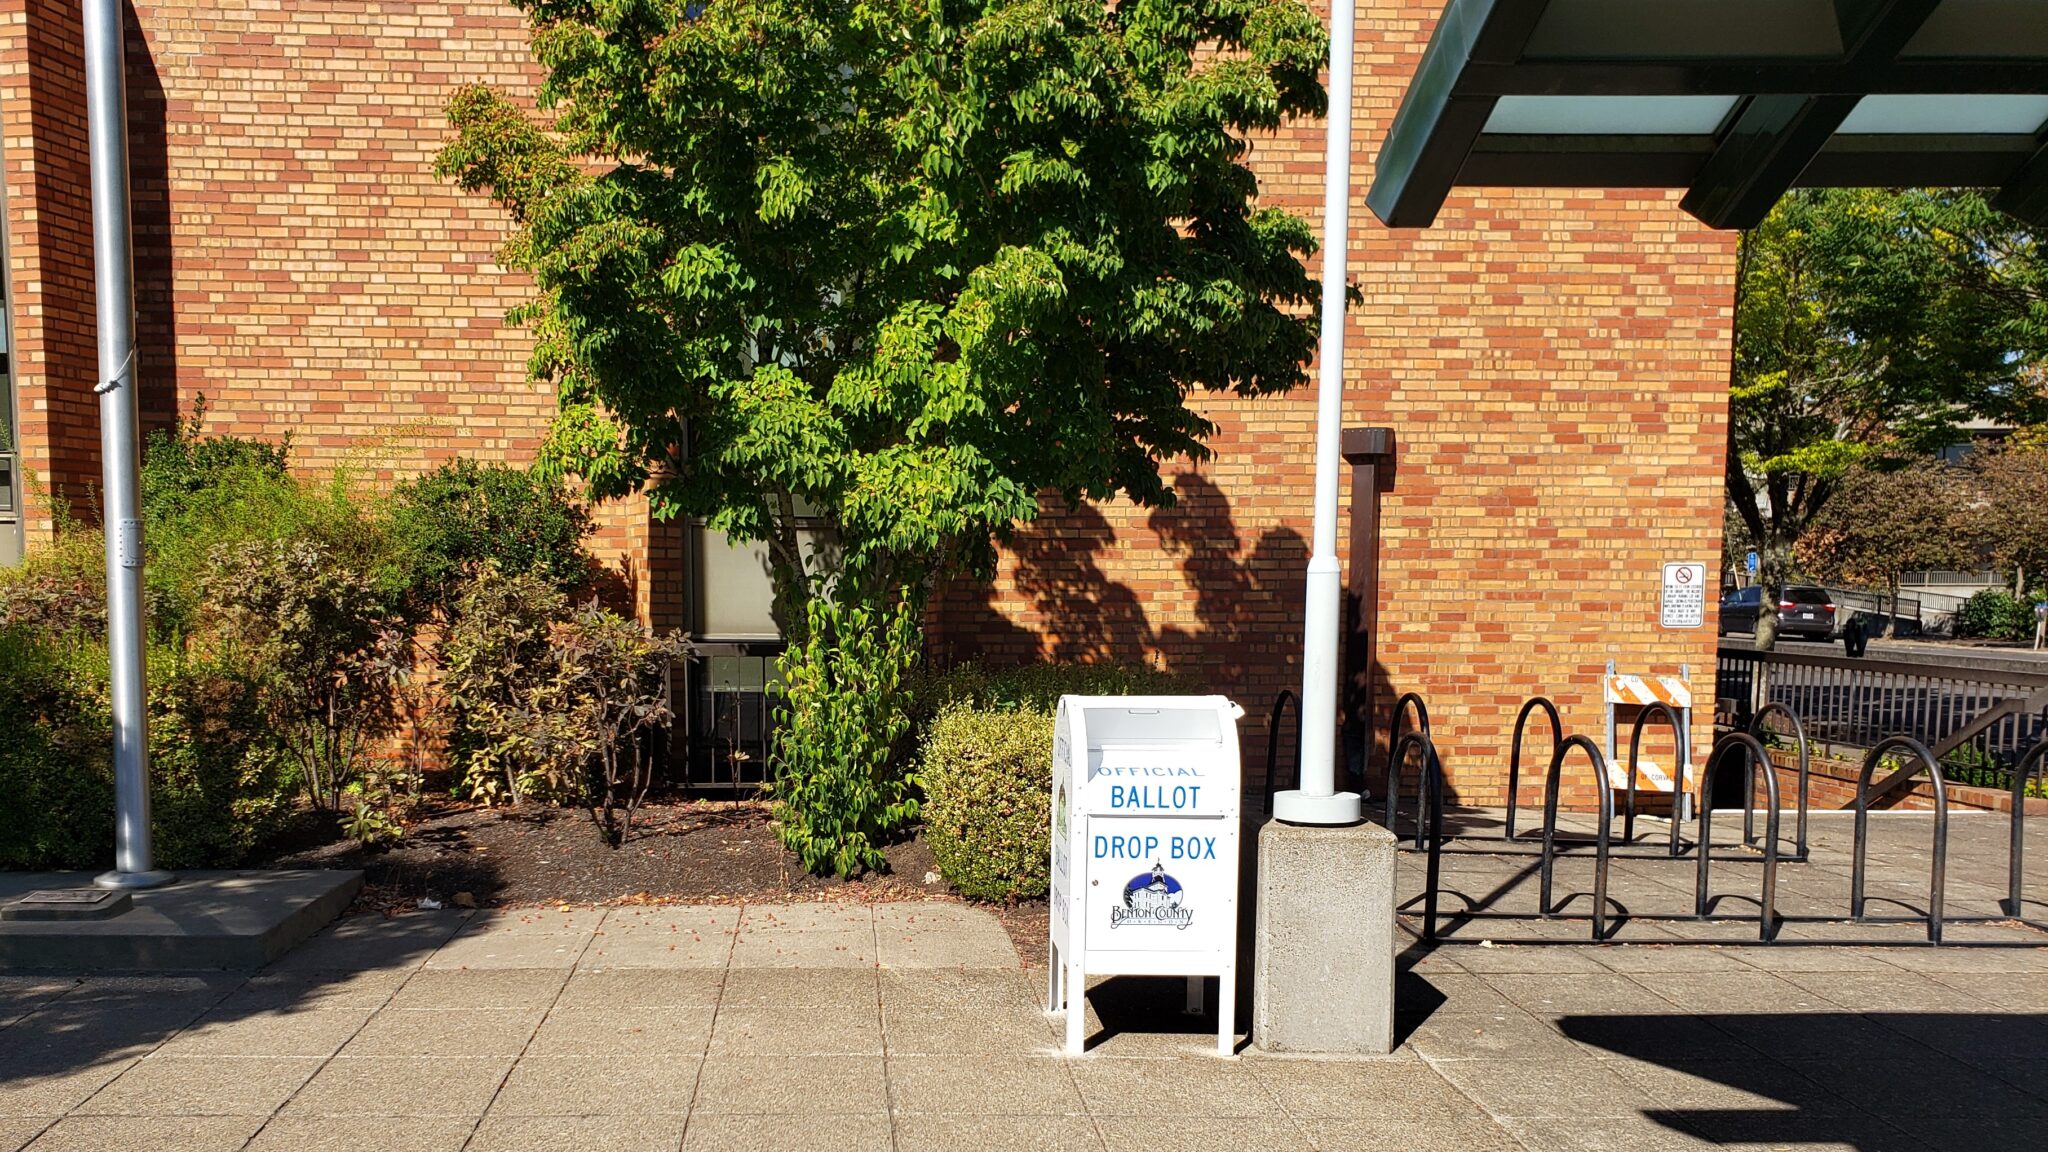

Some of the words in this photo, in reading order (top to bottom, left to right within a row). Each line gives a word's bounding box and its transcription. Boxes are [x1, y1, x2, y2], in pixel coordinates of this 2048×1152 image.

[1097, 766, 1206, 777] OFFICIAL
[1111, 785, 1201, 809] BALLOT
[1094, 835, 1159, 859] DROP
[1170, 836, 1217, 860] BOX
